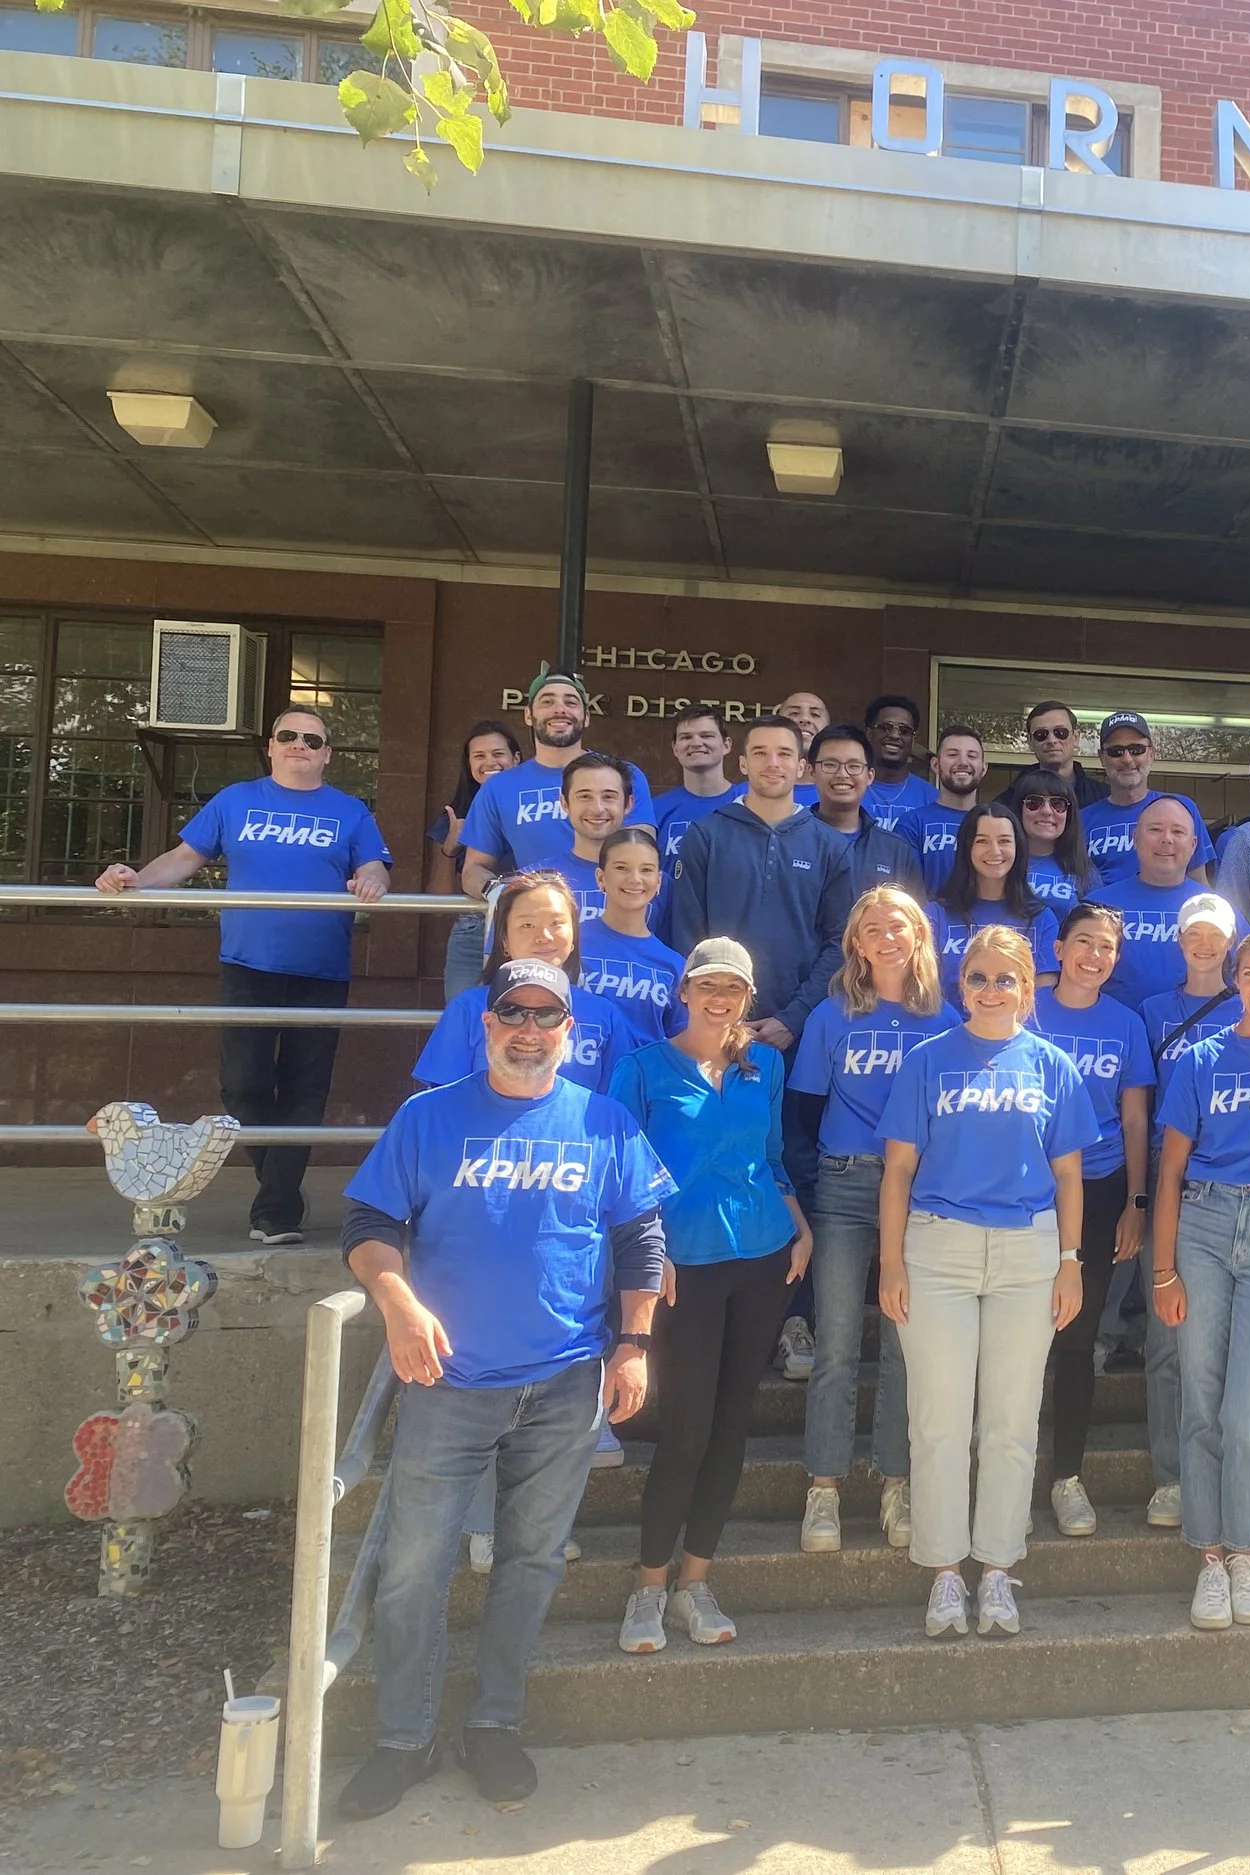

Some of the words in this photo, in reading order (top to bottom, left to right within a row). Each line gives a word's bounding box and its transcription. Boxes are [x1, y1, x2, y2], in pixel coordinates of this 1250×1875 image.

[583, 646, 756, 675] HICAGO
[502, 688, 606, 716] PK
[1108, 714, 1138, 726] KPMG
[517, 800, 568, 825] KPM
[237, 822, 335, 848] KPMG
[923, 834, 957, 854] KP
[1088, 835, 1136, 857] KPM
[1028, 882, 1072, 899] MG
[1121, 922, 1180, 943] KPM
[507, 967, 556, 982] KPMG
[843, 1050, 903, 1075] KPM
[1068, 1052, 1120, 1079] MG
[936, 1087, 1043, 1117] KPMG
[453, 1158, 586, 1192] KPMG
